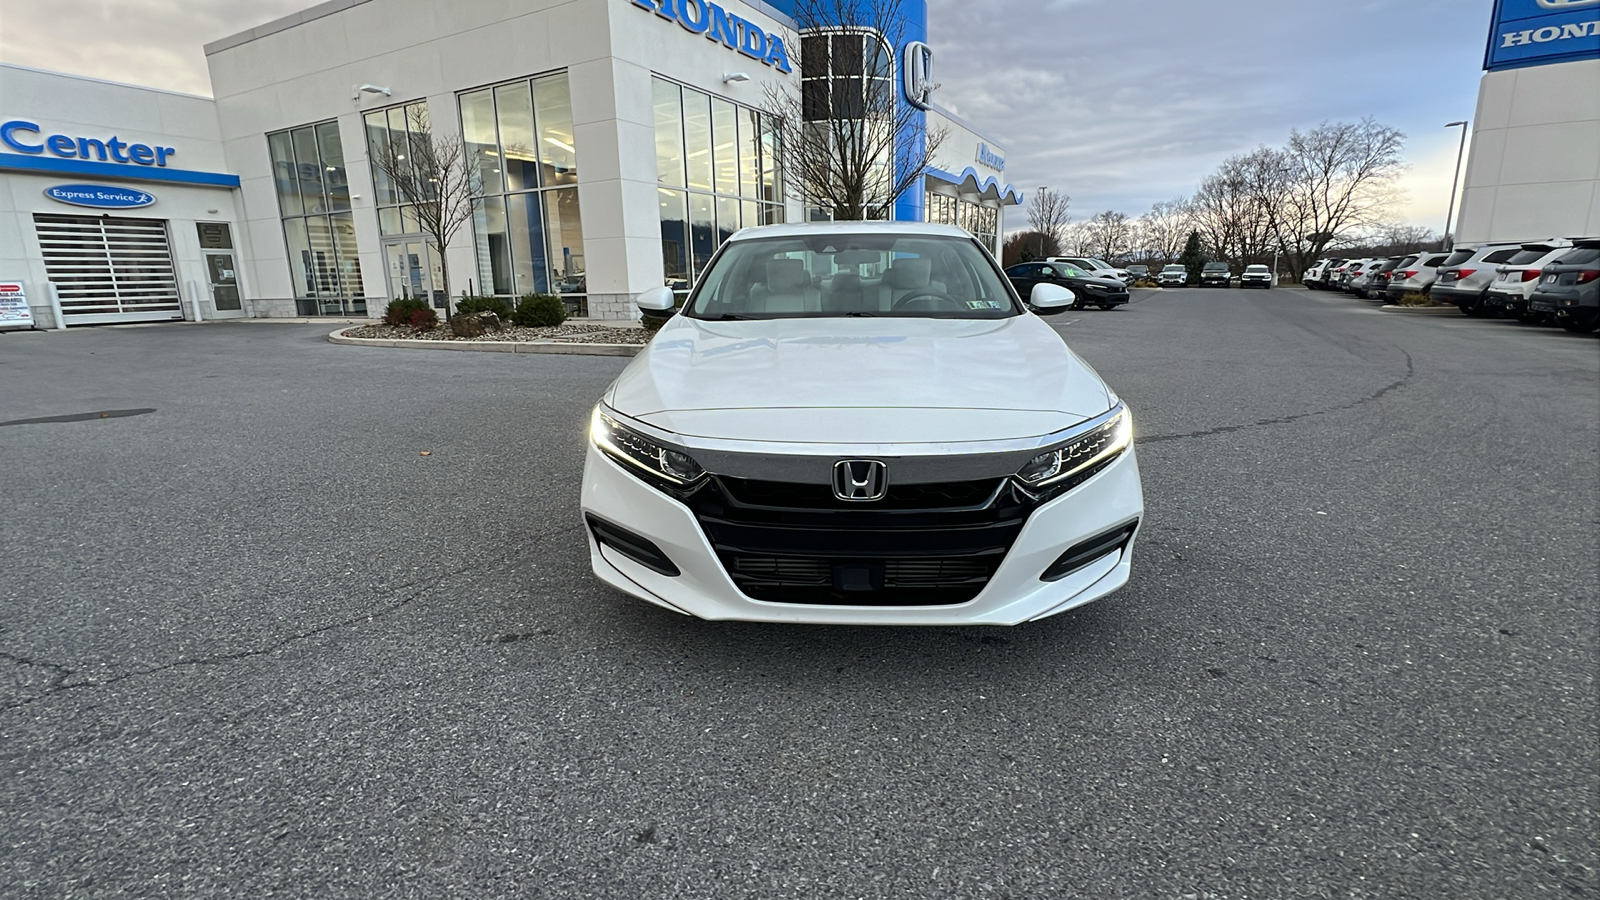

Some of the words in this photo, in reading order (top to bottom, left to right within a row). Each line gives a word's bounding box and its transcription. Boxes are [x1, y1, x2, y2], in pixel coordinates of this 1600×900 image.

[0, 120, 175, 167] Center
[52, 188, 95, 200] Express
[96, 191, 135, 202] Service
